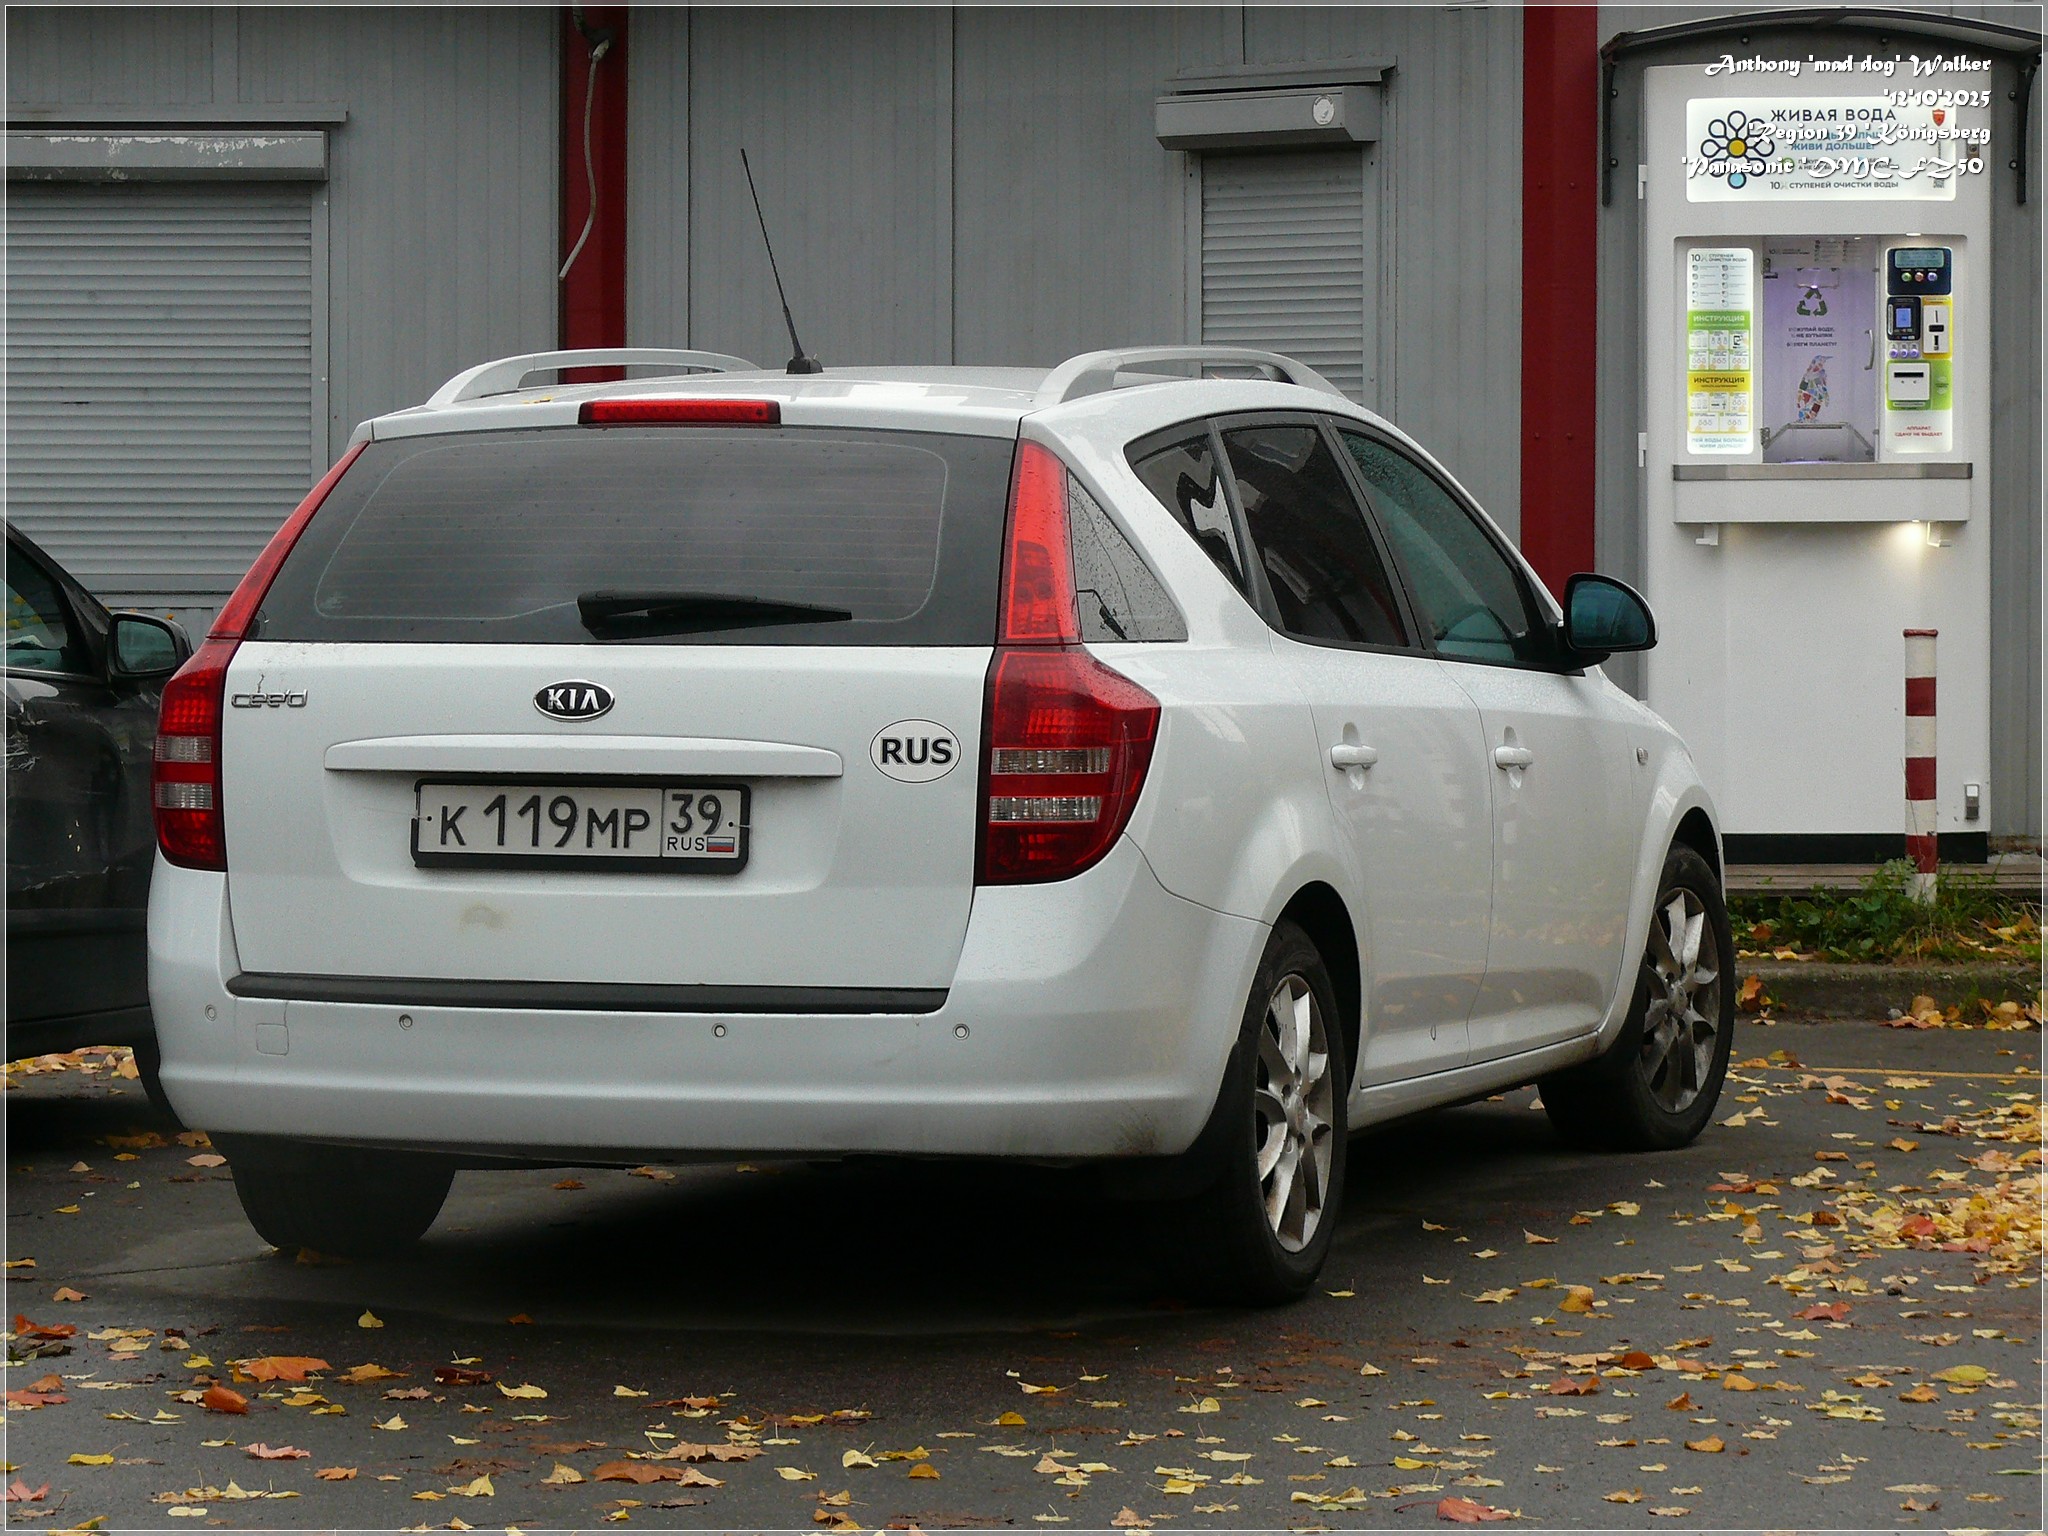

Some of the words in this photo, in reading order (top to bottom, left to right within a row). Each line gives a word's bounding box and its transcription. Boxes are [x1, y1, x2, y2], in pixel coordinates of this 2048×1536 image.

[1770, 109, 1838, 122] ЖИВАЯ
[1844, 108, 1897, 123] ВОДА
[1789, 180, 1832, 189] СТУПЕНЕЙ
[1833, 181, 1872, 189] ОЧИСТКИ
[1873, 181, 1899, 189] ВОДЫ
[547, 688, 599, 710] KIA
[880, 736, 953, 766] RUS
[667, 836, 705, 852] RUS
